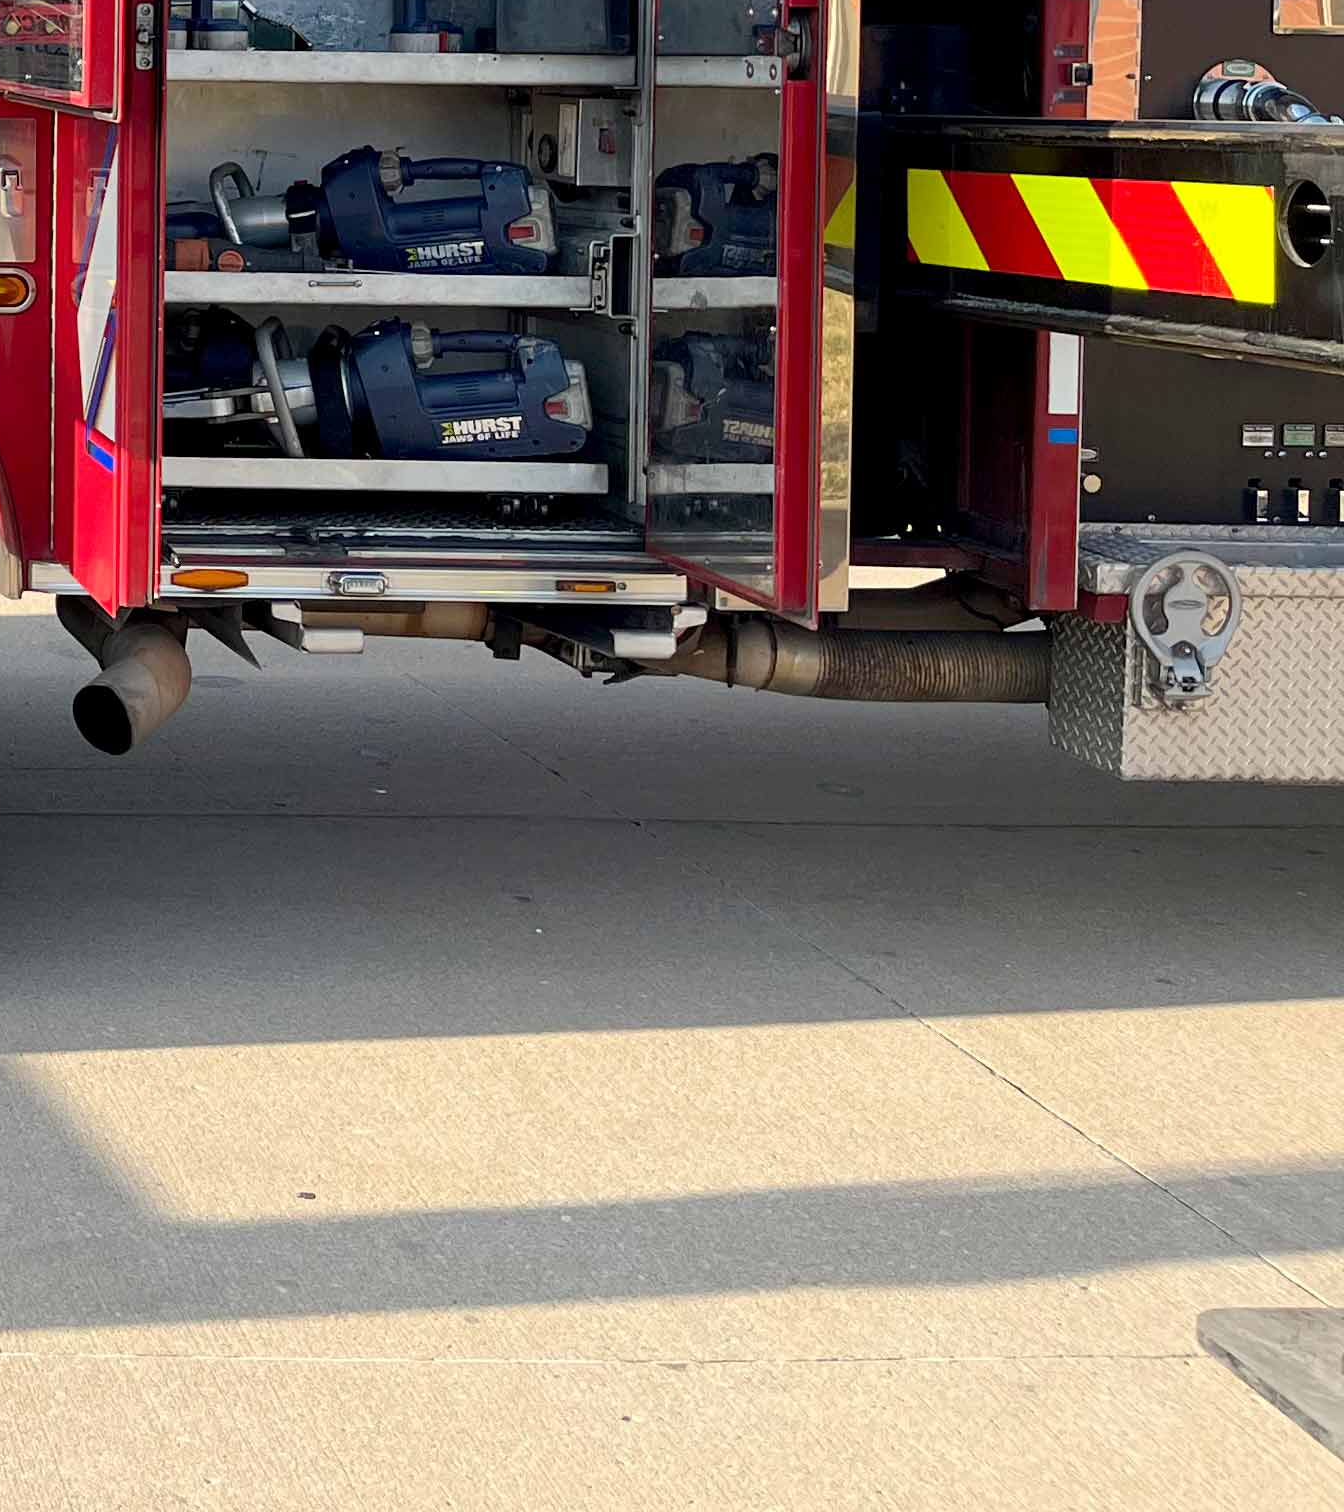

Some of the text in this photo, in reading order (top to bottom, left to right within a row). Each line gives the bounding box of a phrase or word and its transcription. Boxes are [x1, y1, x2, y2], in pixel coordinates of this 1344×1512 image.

[417, 241, 485, 261] HURST
[452, 416, 522, 435] HURST
[442, 431, 520, 445] JAWS OF LIFE
